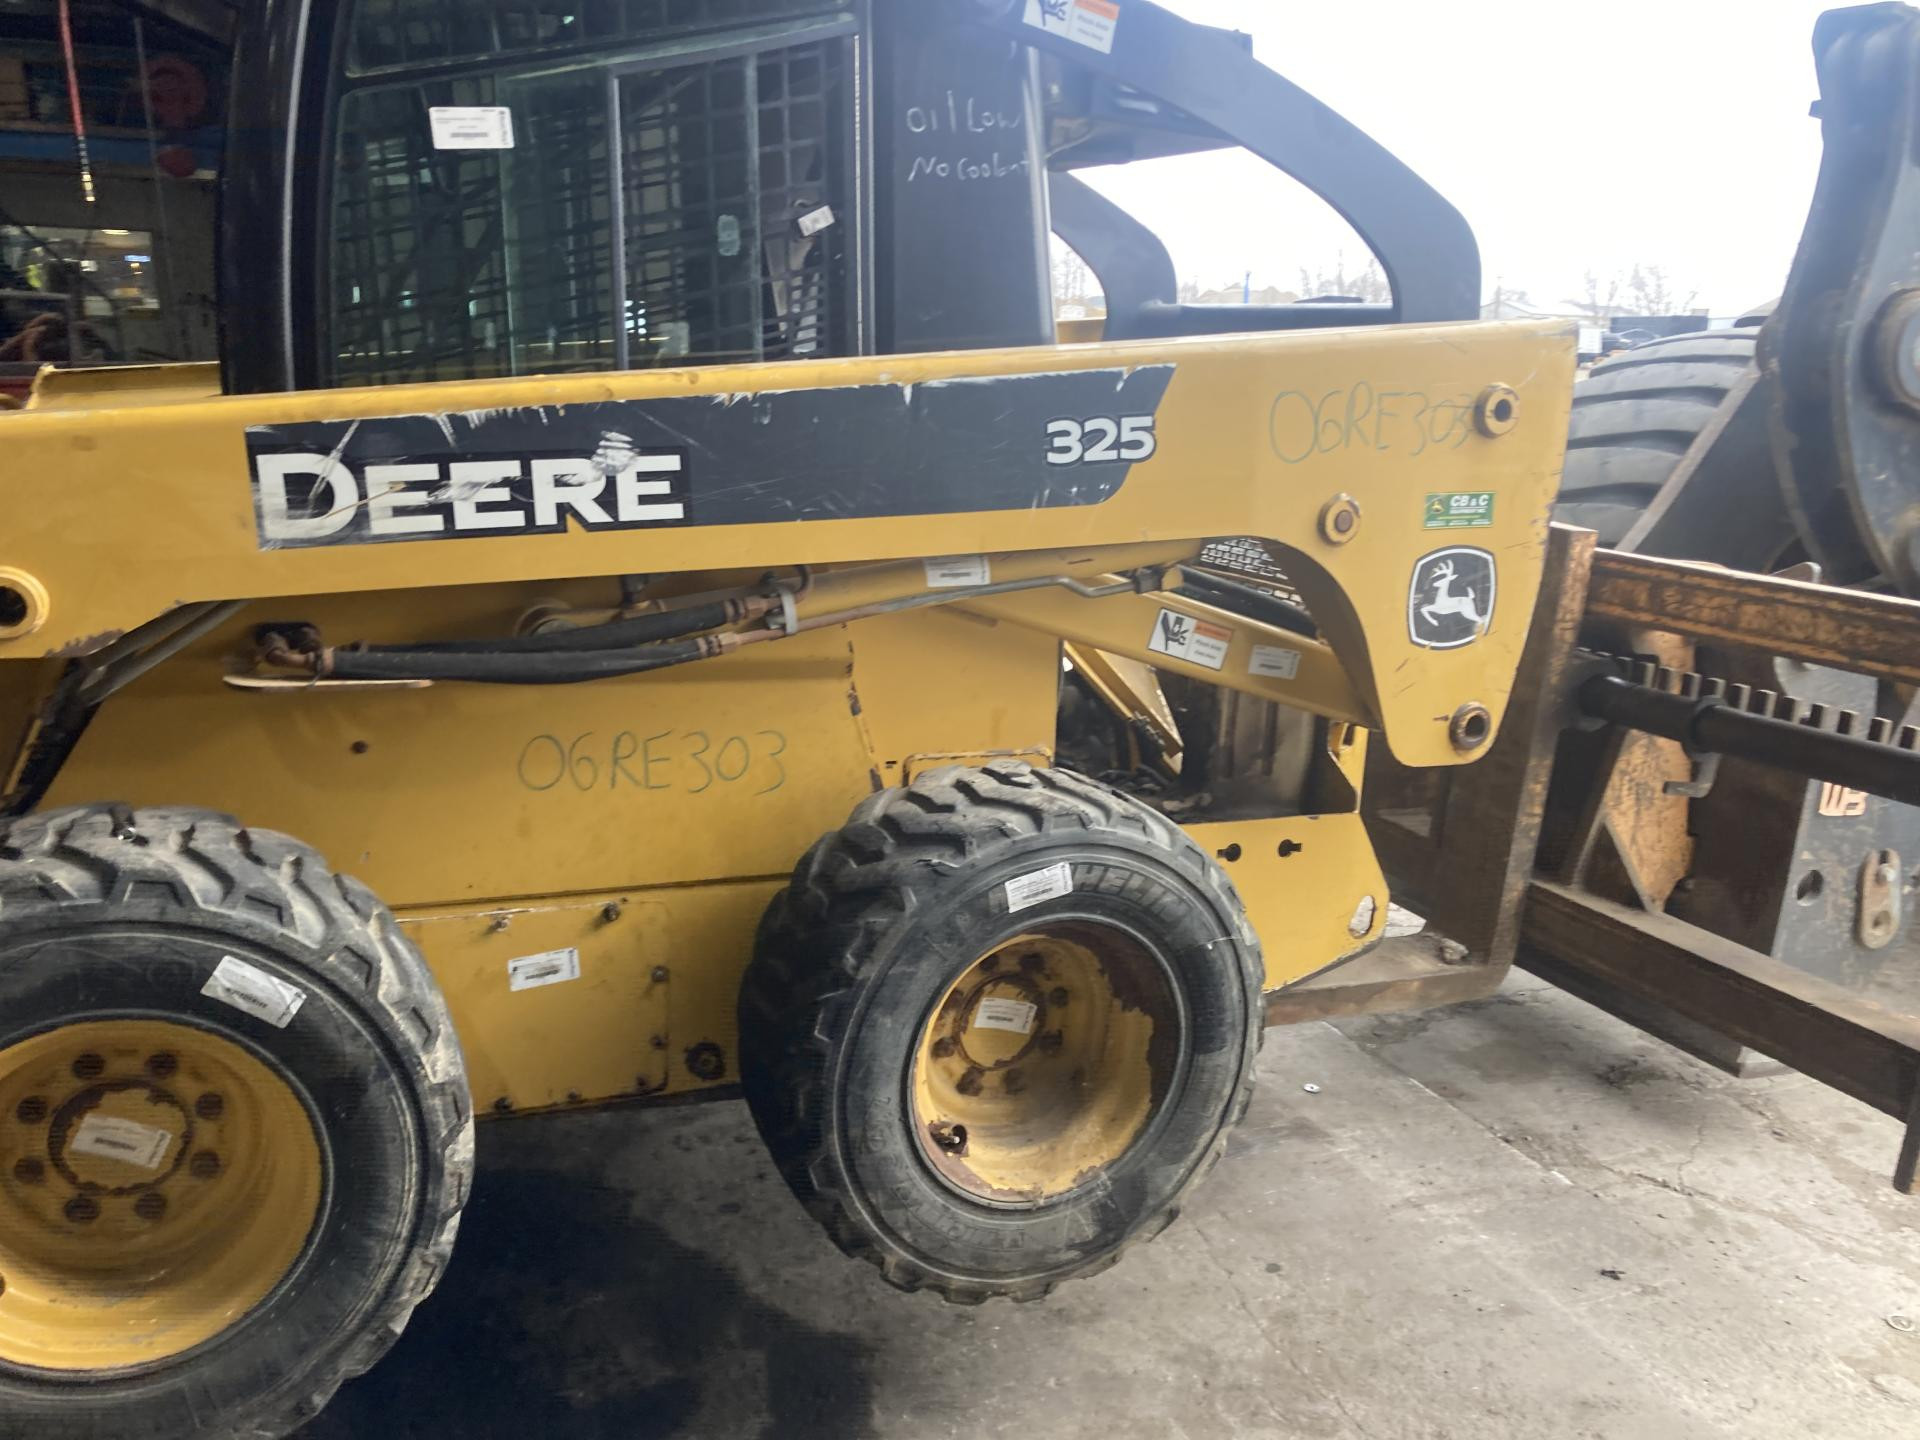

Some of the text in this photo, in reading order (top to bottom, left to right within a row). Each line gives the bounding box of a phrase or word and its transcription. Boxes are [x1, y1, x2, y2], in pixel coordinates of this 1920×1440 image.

[907, 156, 949, 181] No
[1046, 416, 1155, 464] 325
[256, 453, 685, 540] DEERE
